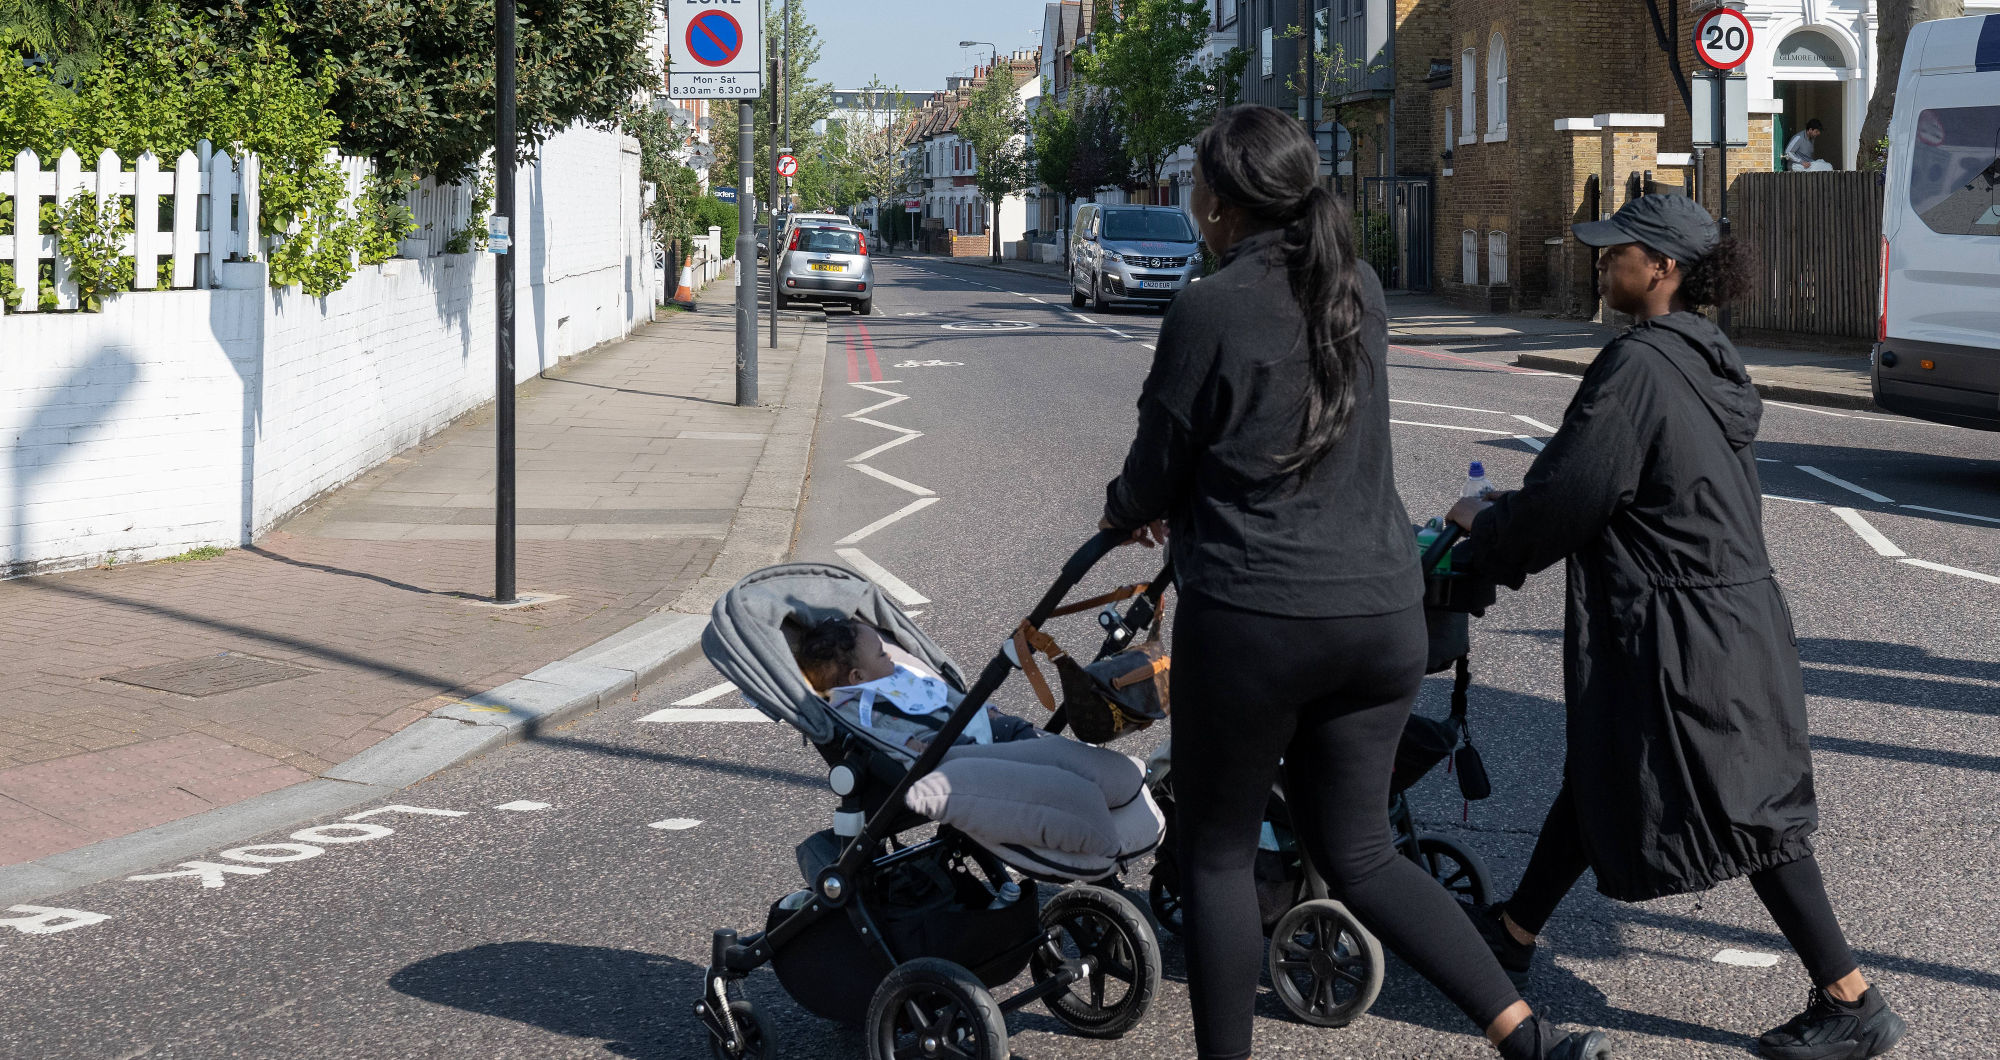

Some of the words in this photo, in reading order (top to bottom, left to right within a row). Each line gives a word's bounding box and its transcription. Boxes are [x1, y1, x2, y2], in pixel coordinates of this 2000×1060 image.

[1706, 25, 1745, 51] 20
[673, 87, 696, 95] 8.30
[718, 87, 742, 95] 6.30
[743, 88, 757, 96] pm
[693, 76, 713, 84] Mon
[720, 76, 736, 84] Sat
[125, 804, 475, 889] LOOK
[0, 903, 113, 935] R
